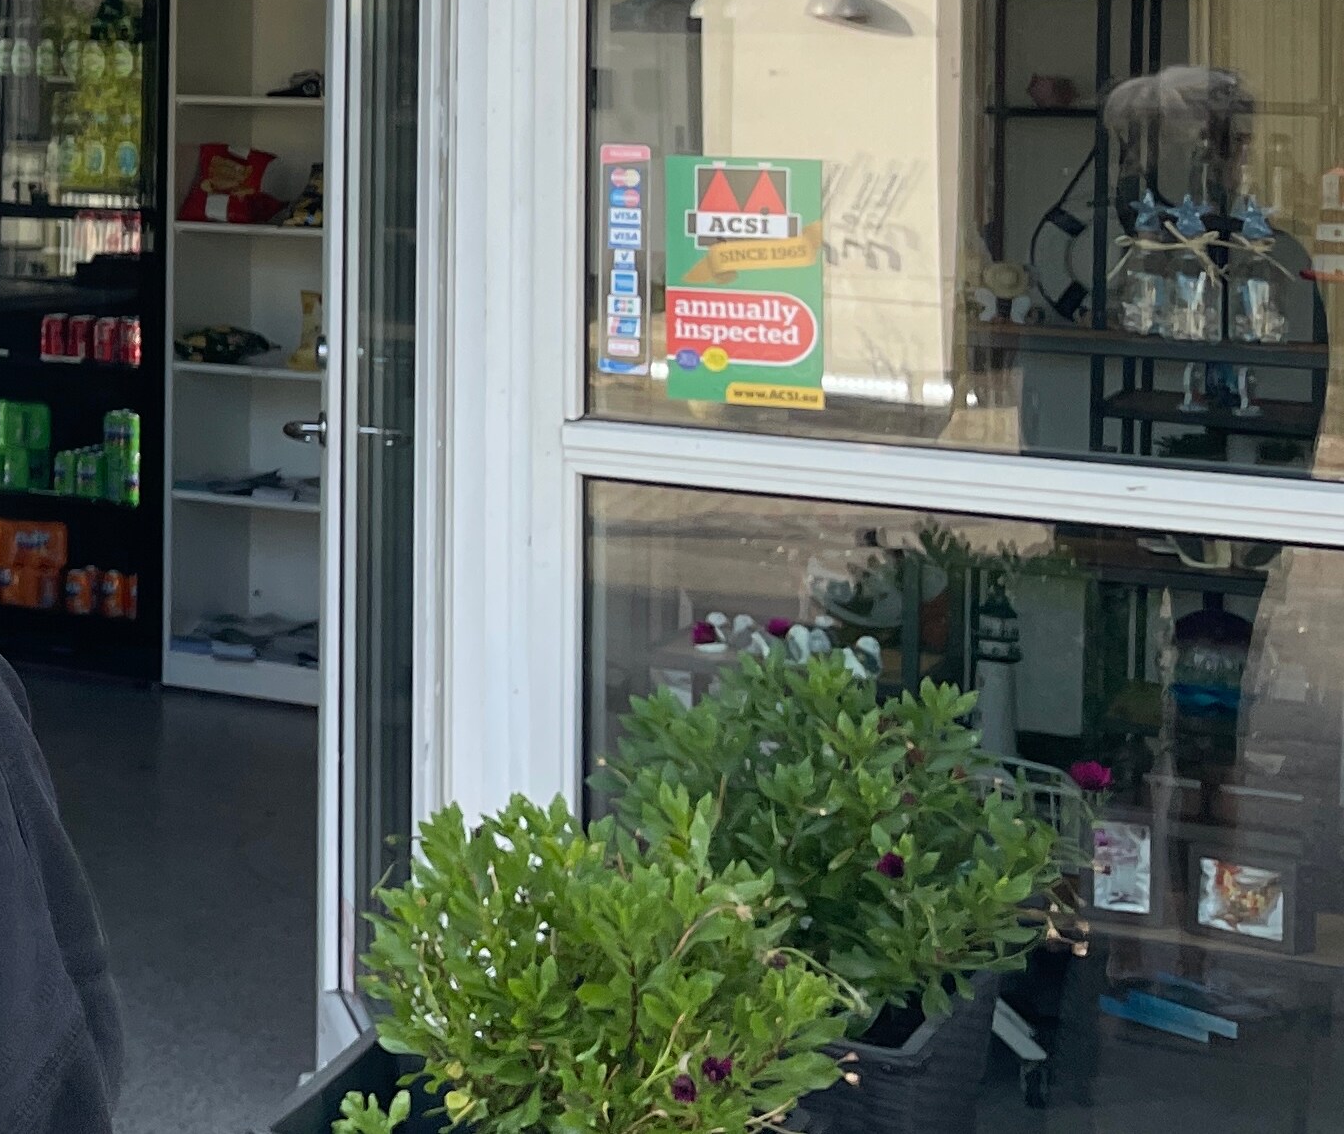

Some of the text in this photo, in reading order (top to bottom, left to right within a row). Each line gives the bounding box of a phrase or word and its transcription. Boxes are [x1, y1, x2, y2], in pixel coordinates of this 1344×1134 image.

[719, 245, 807, 264] SINCE 1965
[674, 297, 799, 326] annually
[674, 316, 801, 346] inspected
